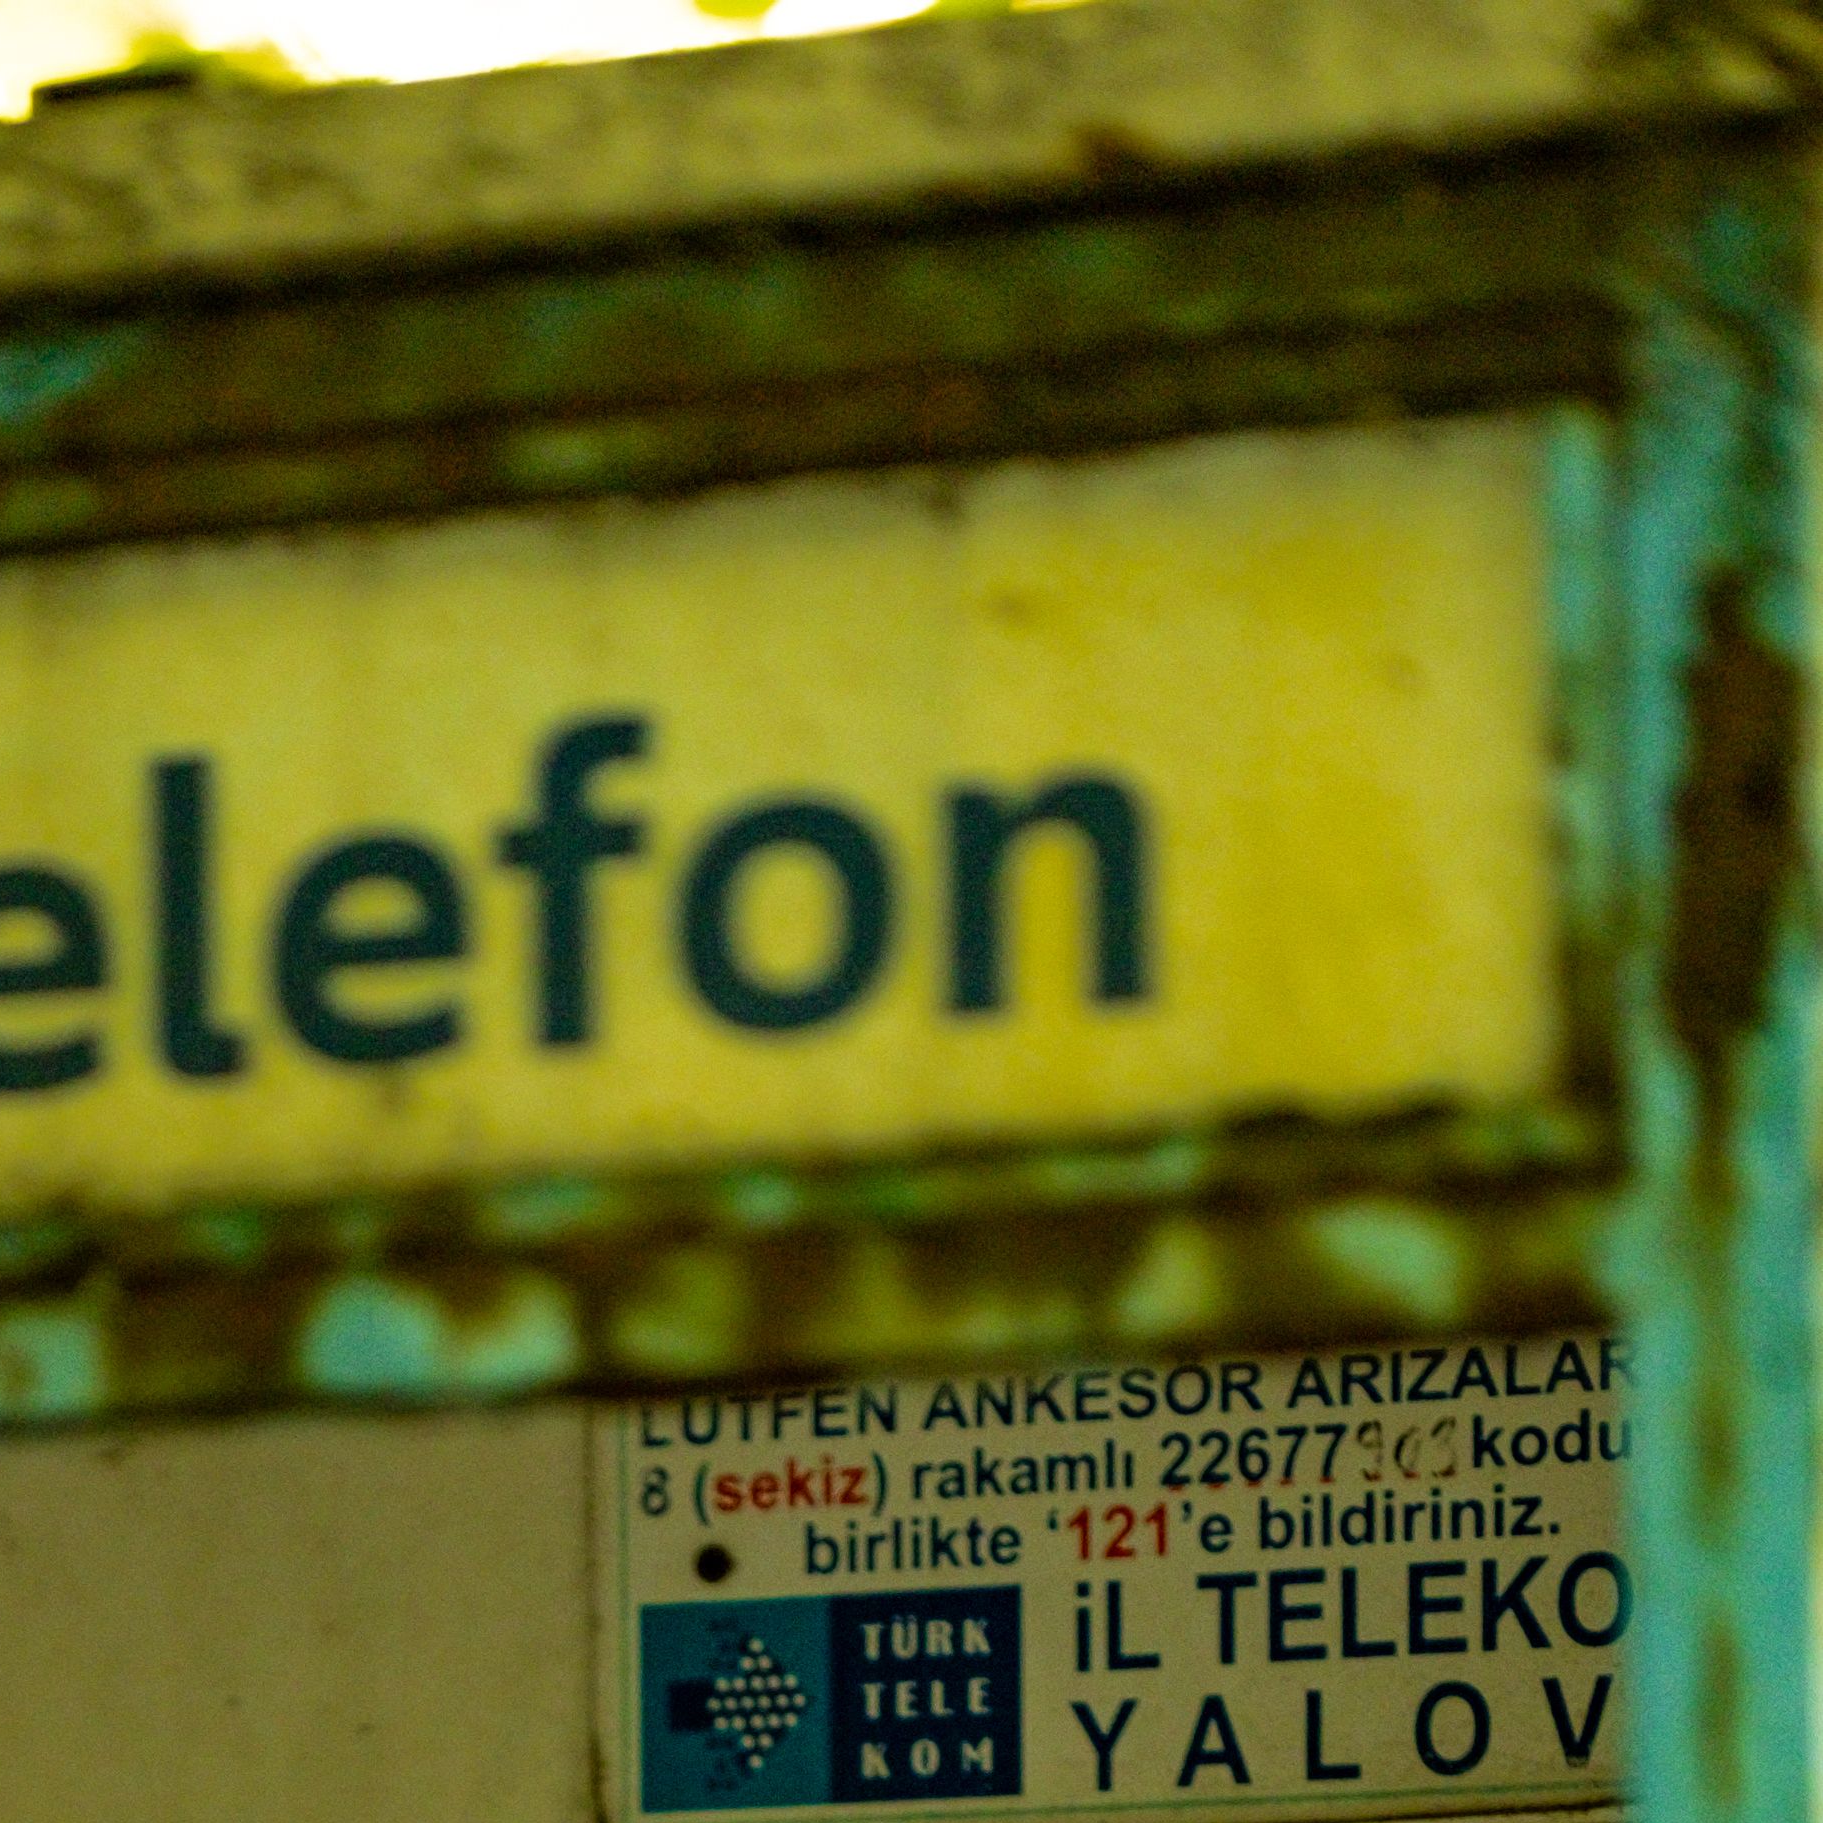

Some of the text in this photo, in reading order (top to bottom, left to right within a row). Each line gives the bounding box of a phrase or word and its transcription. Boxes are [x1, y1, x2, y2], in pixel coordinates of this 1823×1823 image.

[924, 1361, 1263, 1430] ANKESOR
[641, 1465, 671, 1516] 8
[695, 1453, 887, 1526] (sekiz)
[912, 1438, 1133, 1500] rakamlı
[805, 1517, 1021, 1575] birlikte
[1260, 1484, 1560, 1551] bildiriniz.
[860, 1614, 991, 1661] TÜRK
[1196, 1550, 1633, 1665] TELEKO
[861, 1677, 990, 1720] TELE
[1072, 1674, 1613, 1792] YALOV
[861, 1736, 994, 1780] KOM
